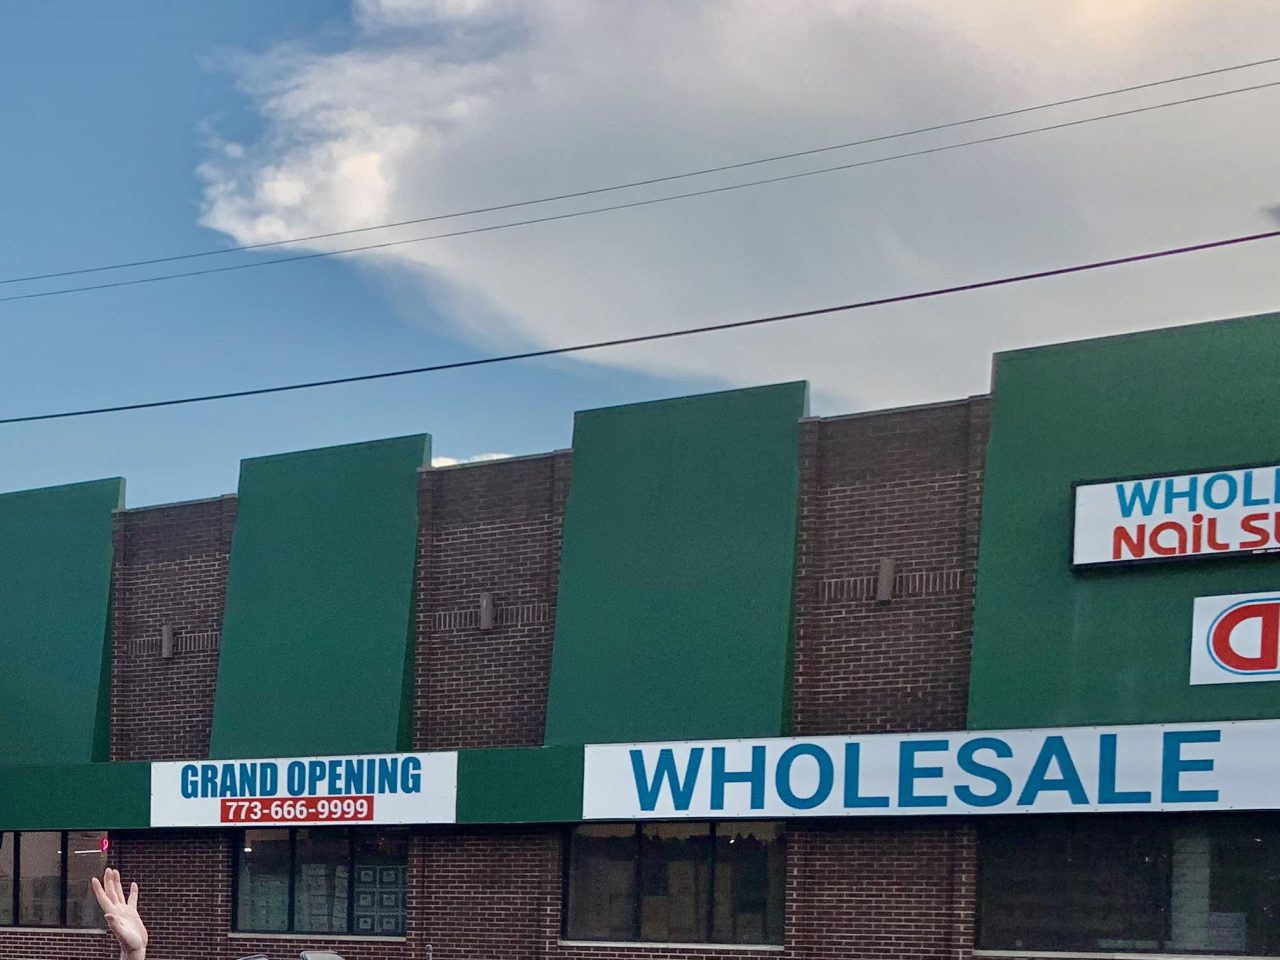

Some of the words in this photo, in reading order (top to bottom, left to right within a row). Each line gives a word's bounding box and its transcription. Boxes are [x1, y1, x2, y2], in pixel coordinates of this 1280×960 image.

[1116, 467, 1280, 518] WHOL
[1239, 512, 1280, 549] S
[180, 762, 278, 799] GRAND
[287, 756, 422, 796] OPENING
[628, 729, 1221, 812] WHOLESALE
[225, 799, 369, 821] 773-666-9999
